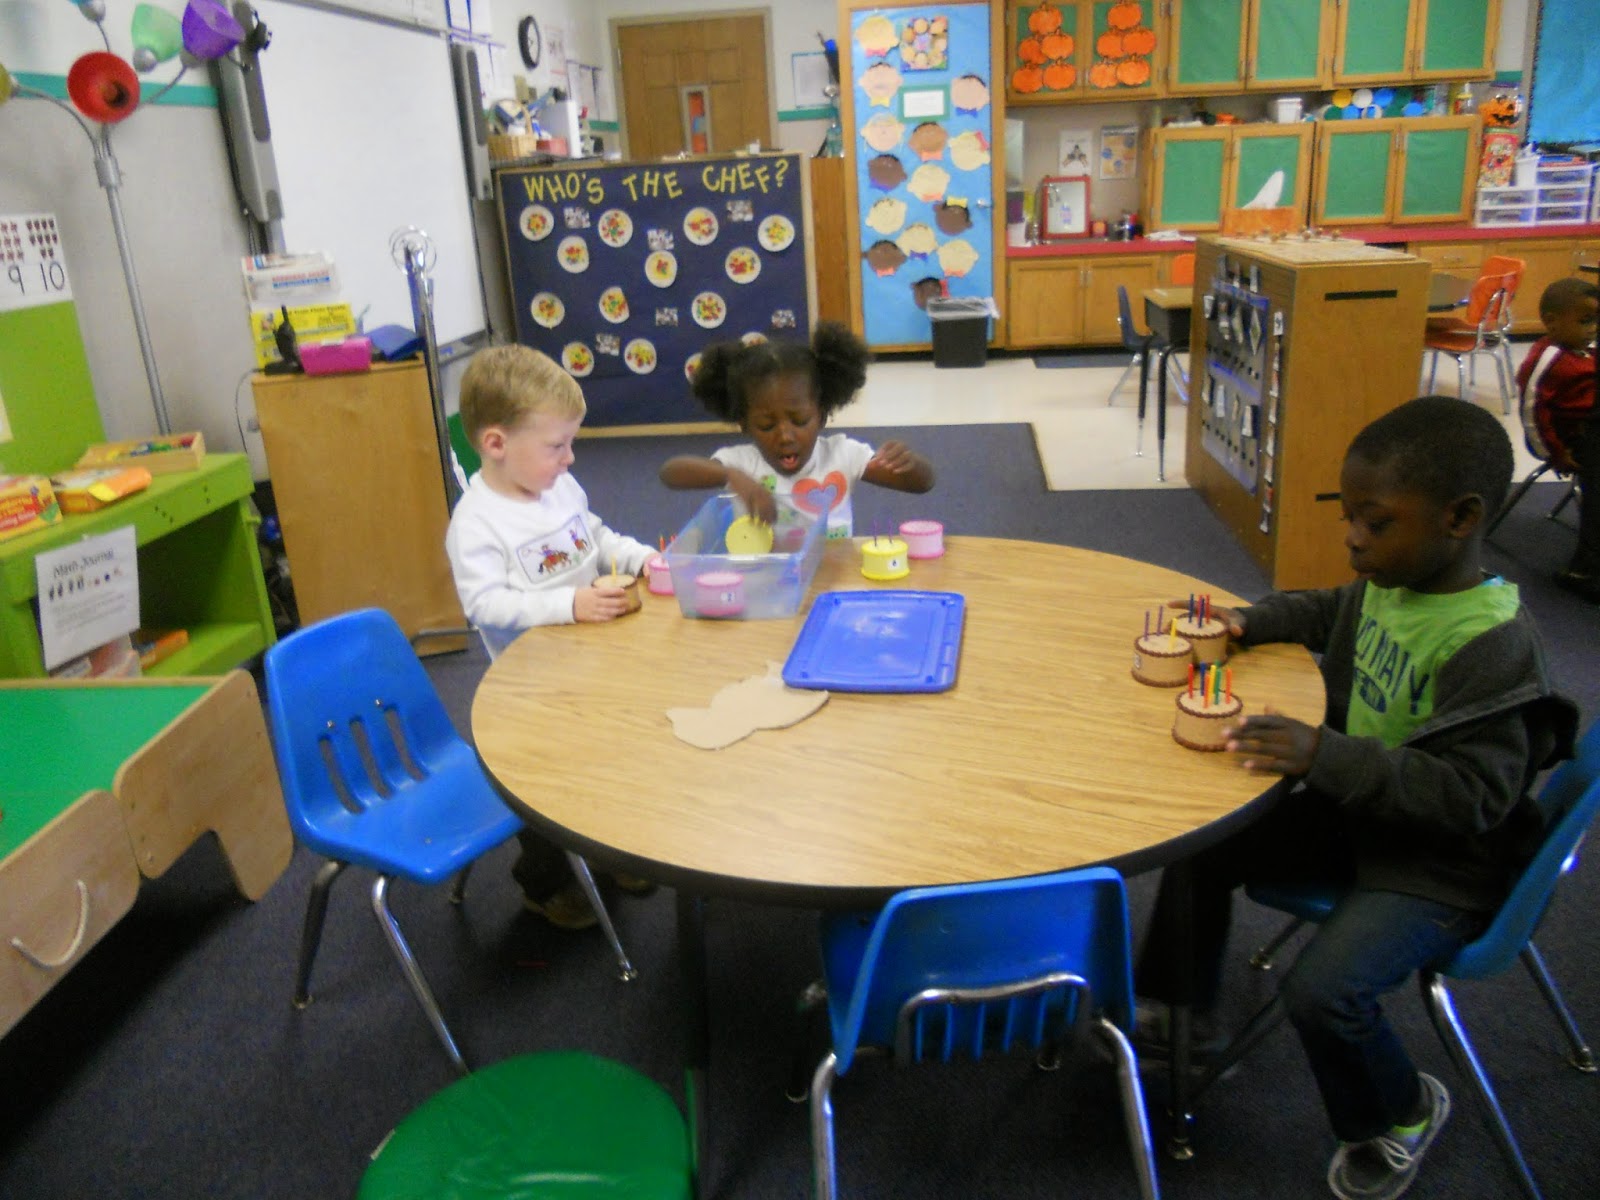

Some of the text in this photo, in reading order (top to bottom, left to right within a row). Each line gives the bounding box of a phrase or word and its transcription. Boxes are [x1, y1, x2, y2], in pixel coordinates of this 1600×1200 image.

[523, 158, 790, 205] WHO'S THE CHEF?
[8, 260, 65, 296] 9 10
